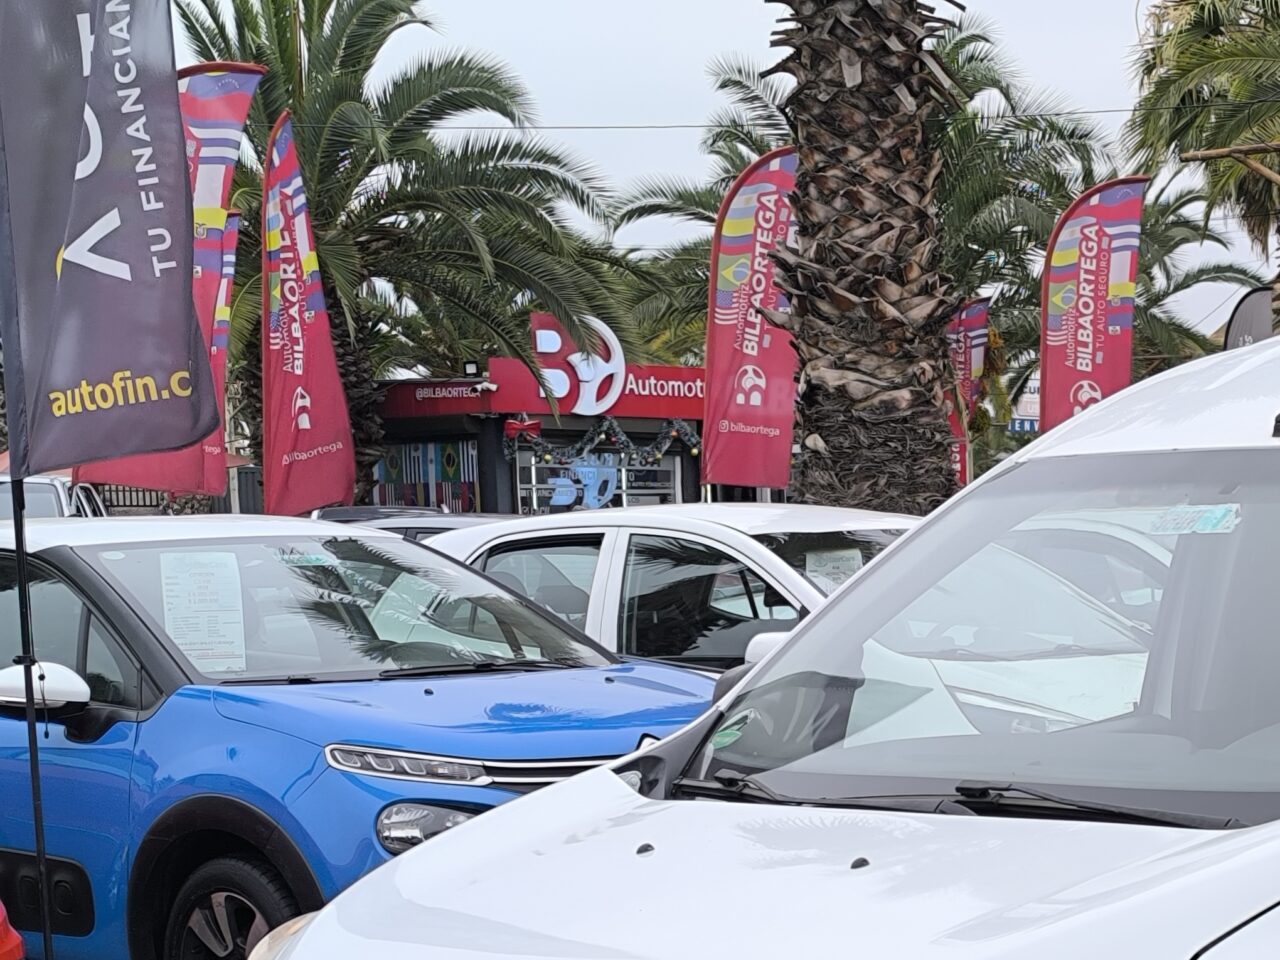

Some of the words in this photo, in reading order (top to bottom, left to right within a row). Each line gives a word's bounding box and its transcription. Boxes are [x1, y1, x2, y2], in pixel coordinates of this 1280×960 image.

[147, 227, 177, 277] TU
[1098, 252, 1109, 297] SEGURO
[1076, 224, 1100, 372] BILBAORTEGA
[1097, 300, 1107, 331] AUTO
[1064, 307, 1076, 368] Automotriz
[1096, 334, 1105, 348] TU
[625, 373, 706, 398] Automot
[730, 422, 780, 438] bilbaortega
